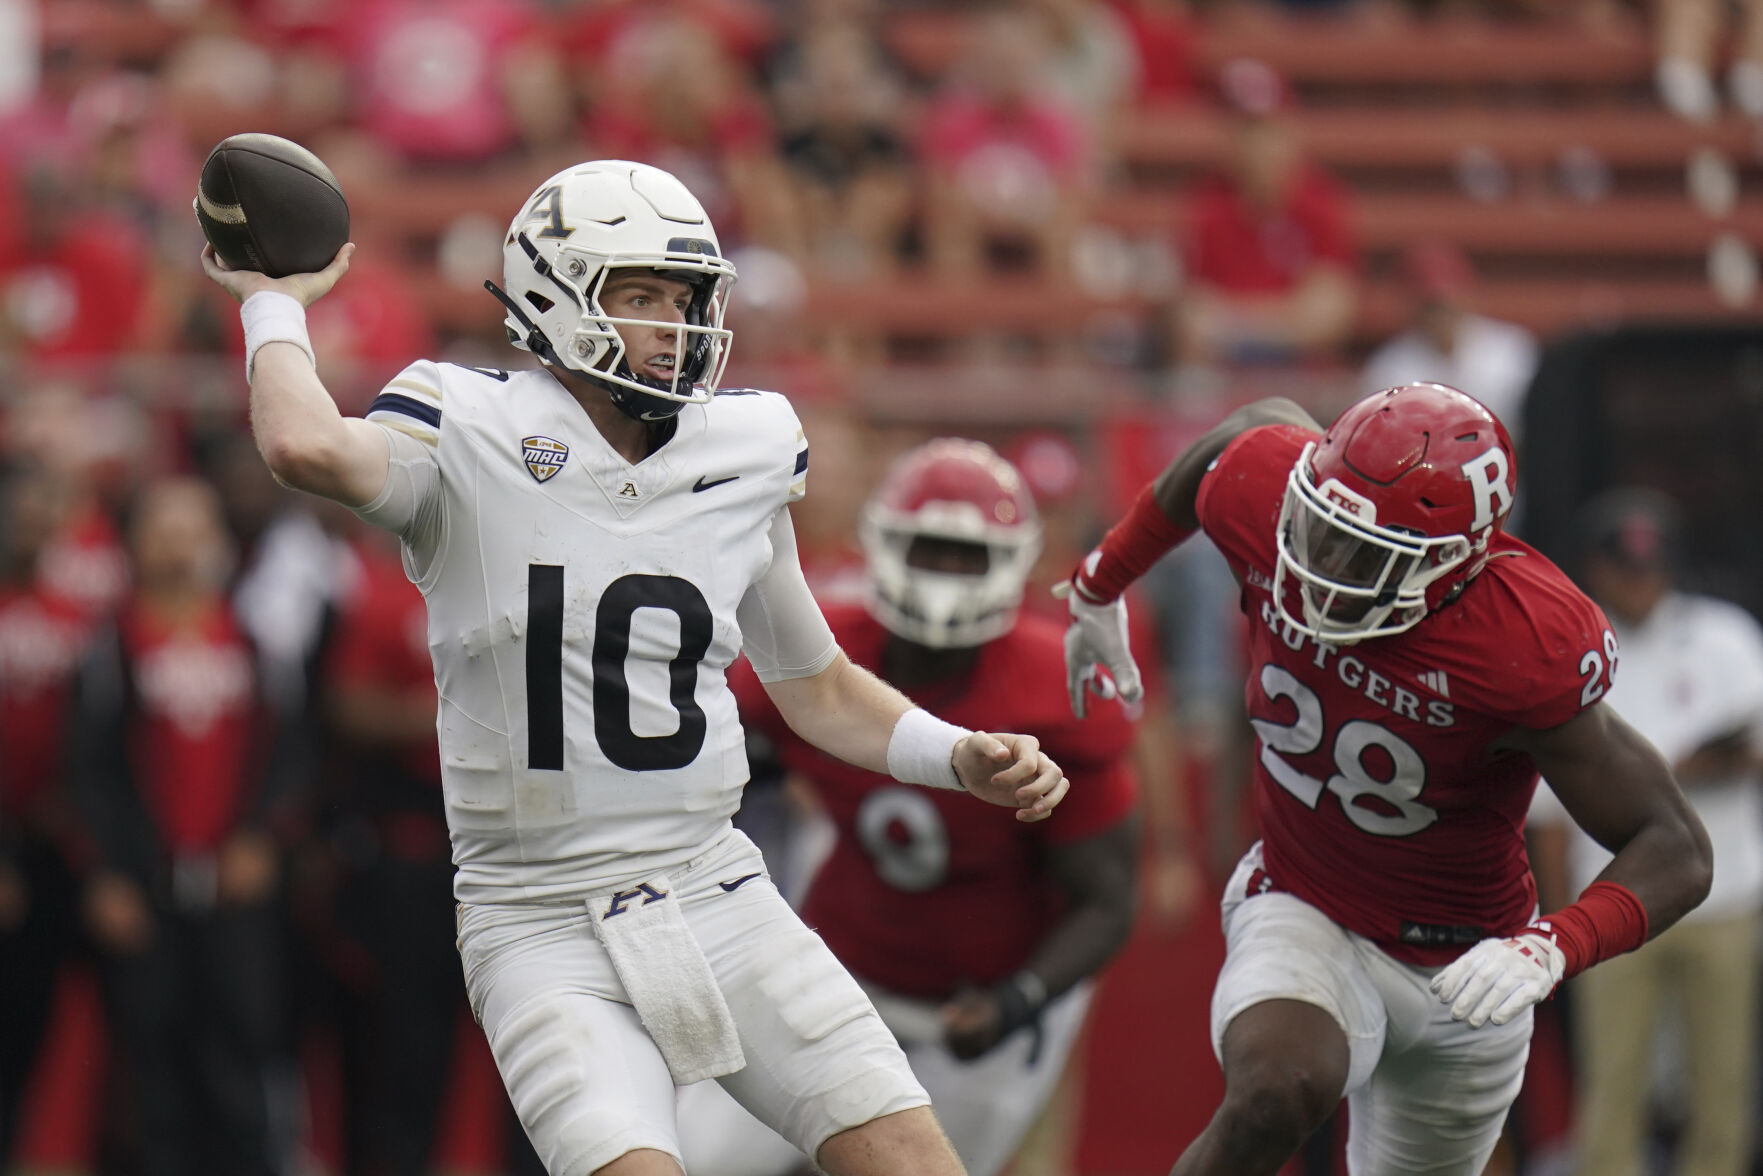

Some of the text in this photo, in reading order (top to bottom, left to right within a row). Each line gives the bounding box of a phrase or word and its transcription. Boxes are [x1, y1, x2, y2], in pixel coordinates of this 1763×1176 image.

[506, 183, 577, 247] A
[696, 333, 714, 361] SPOR
[523, 448, 566, 465] MAC
[619, 482, 639, 497] A
[1461, 446, 1515, 533] R
[526, 563, 713, 772] 10
[1261, 600, 1455, 727] RUTGERS
[1579, 628, 1620, 708] 28
[1249, 663, 1438, 837] 28
